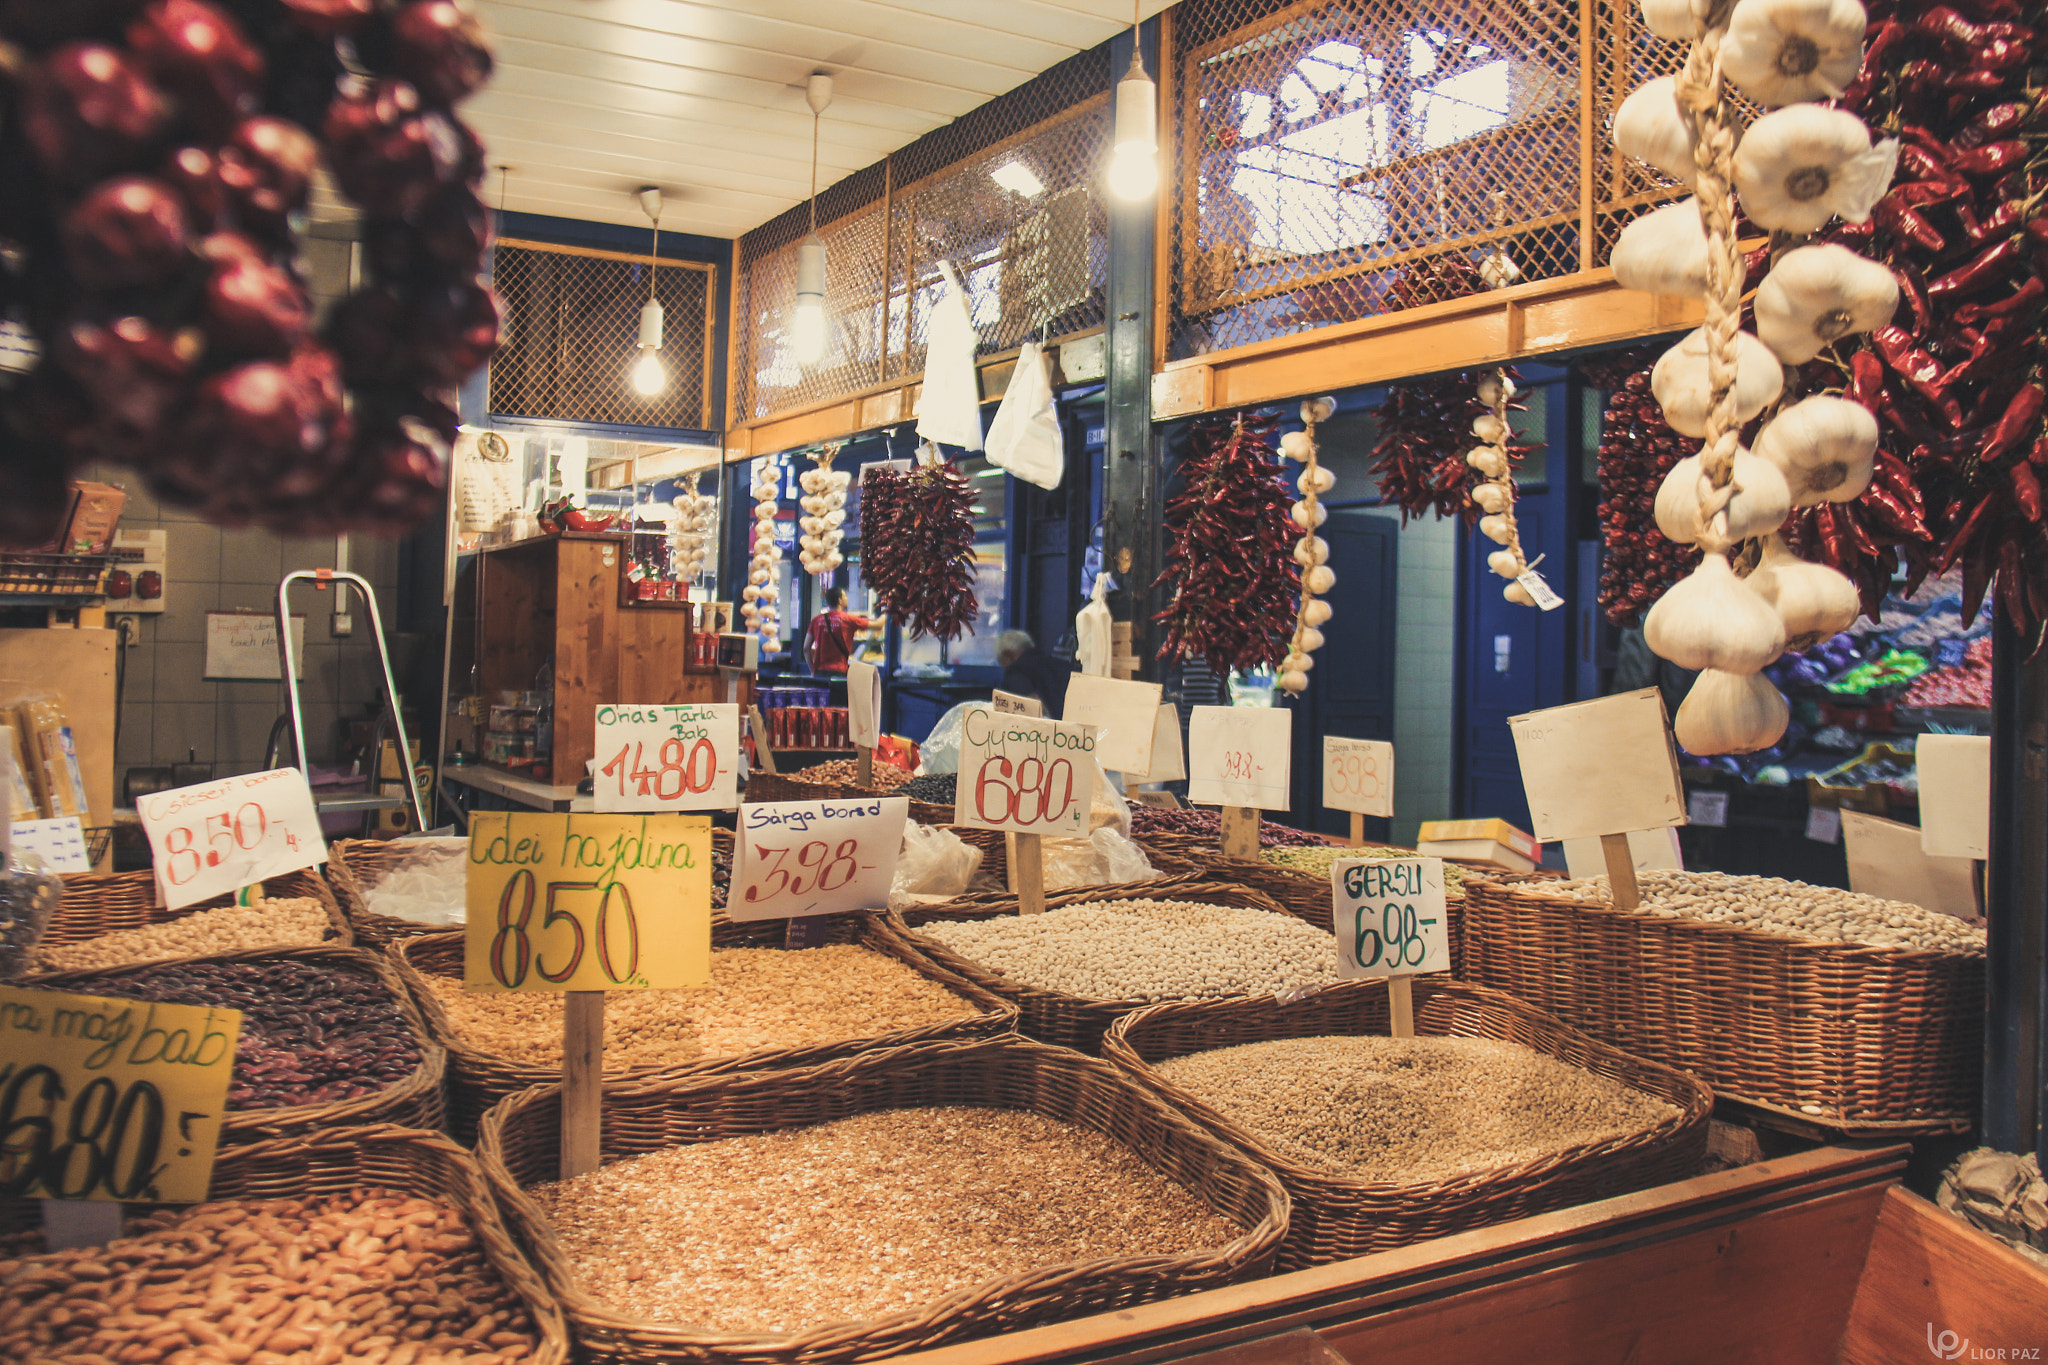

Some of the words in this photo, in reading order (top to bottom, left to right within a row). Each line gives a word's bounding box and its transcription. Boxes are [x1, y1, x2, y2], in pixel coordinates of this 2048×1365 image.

[670, 723, 708, 741] Bab
[559, 814, 696, 891] hajdina
[1343, 863, 1422, 900] GERSLI
